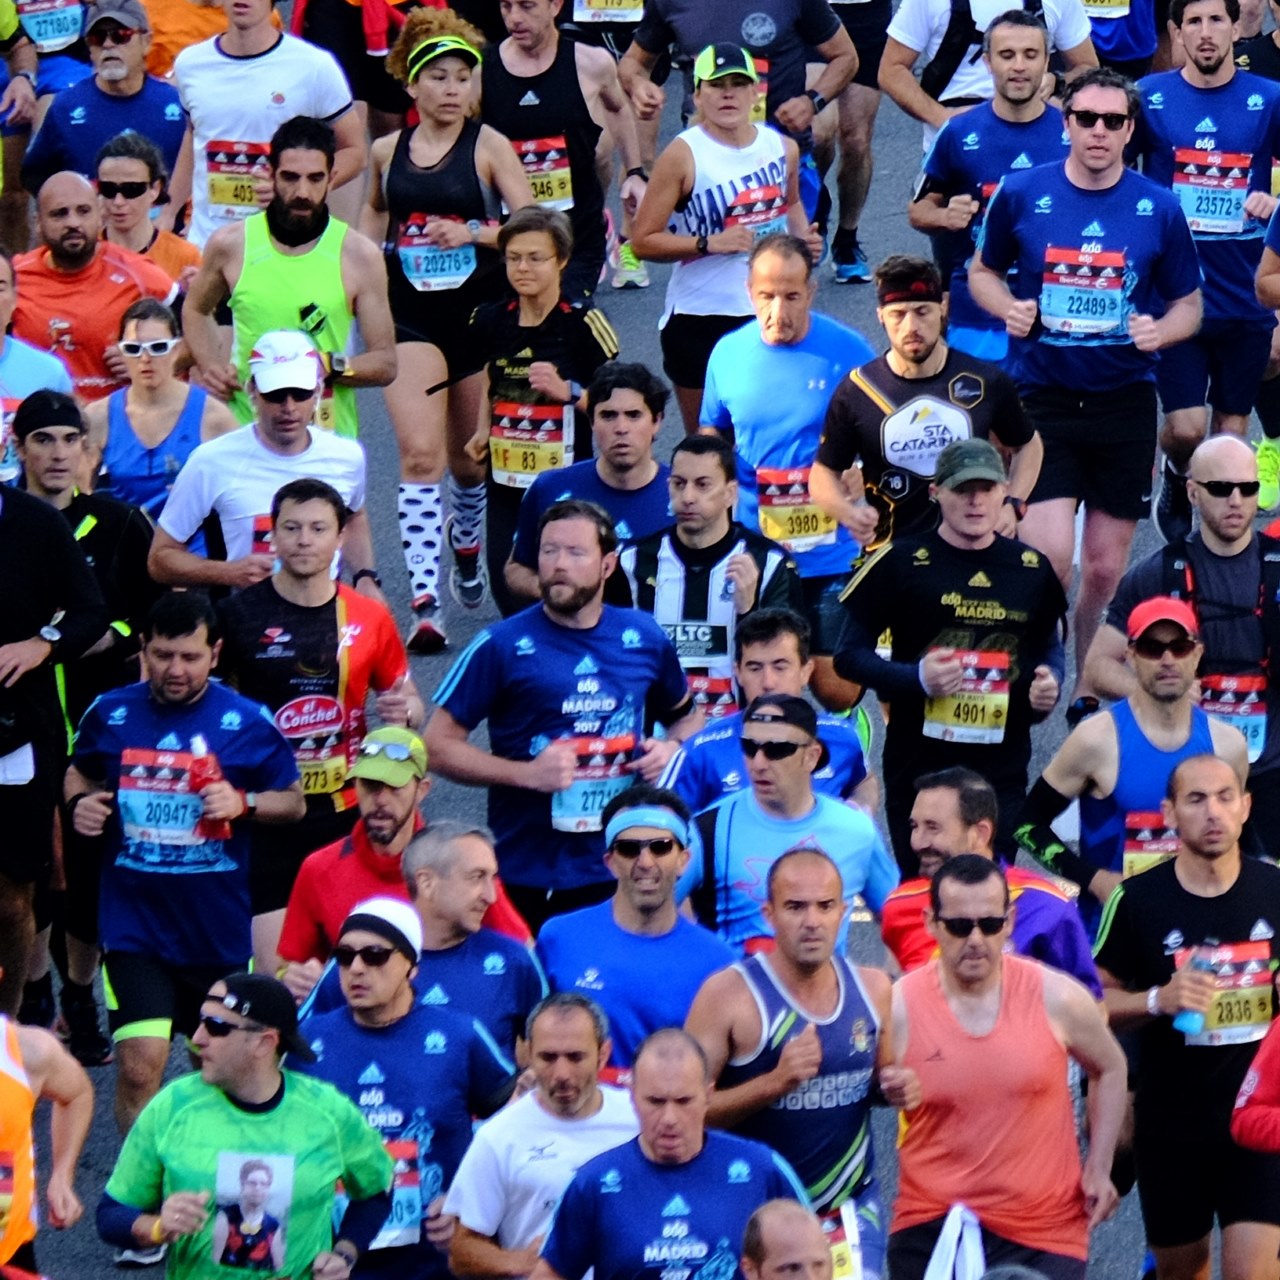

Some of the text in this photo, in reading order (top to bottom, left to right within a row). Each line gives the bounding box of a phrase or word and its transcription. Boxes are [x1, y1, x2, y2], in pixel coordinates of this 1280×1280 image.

[1194, 193, 1233, 216] 23572
[922, 424, 951, 438] STA
[521, 447, 537, 471] 83
[787, 512, 819, 536] 3980
[954, 609, 1007, 623] MADRID
[675, 625, 713, 641] LTC
[561, 699, 617, 716] MADRID
[953, 702, 989, 726] 4901
[572, 720, 603, 735] 2017
[149, 802, 194, 825] 20947
[1216, 999, 1253, 1024] 2836
[642, 1240, 709, 1264] MADRID
